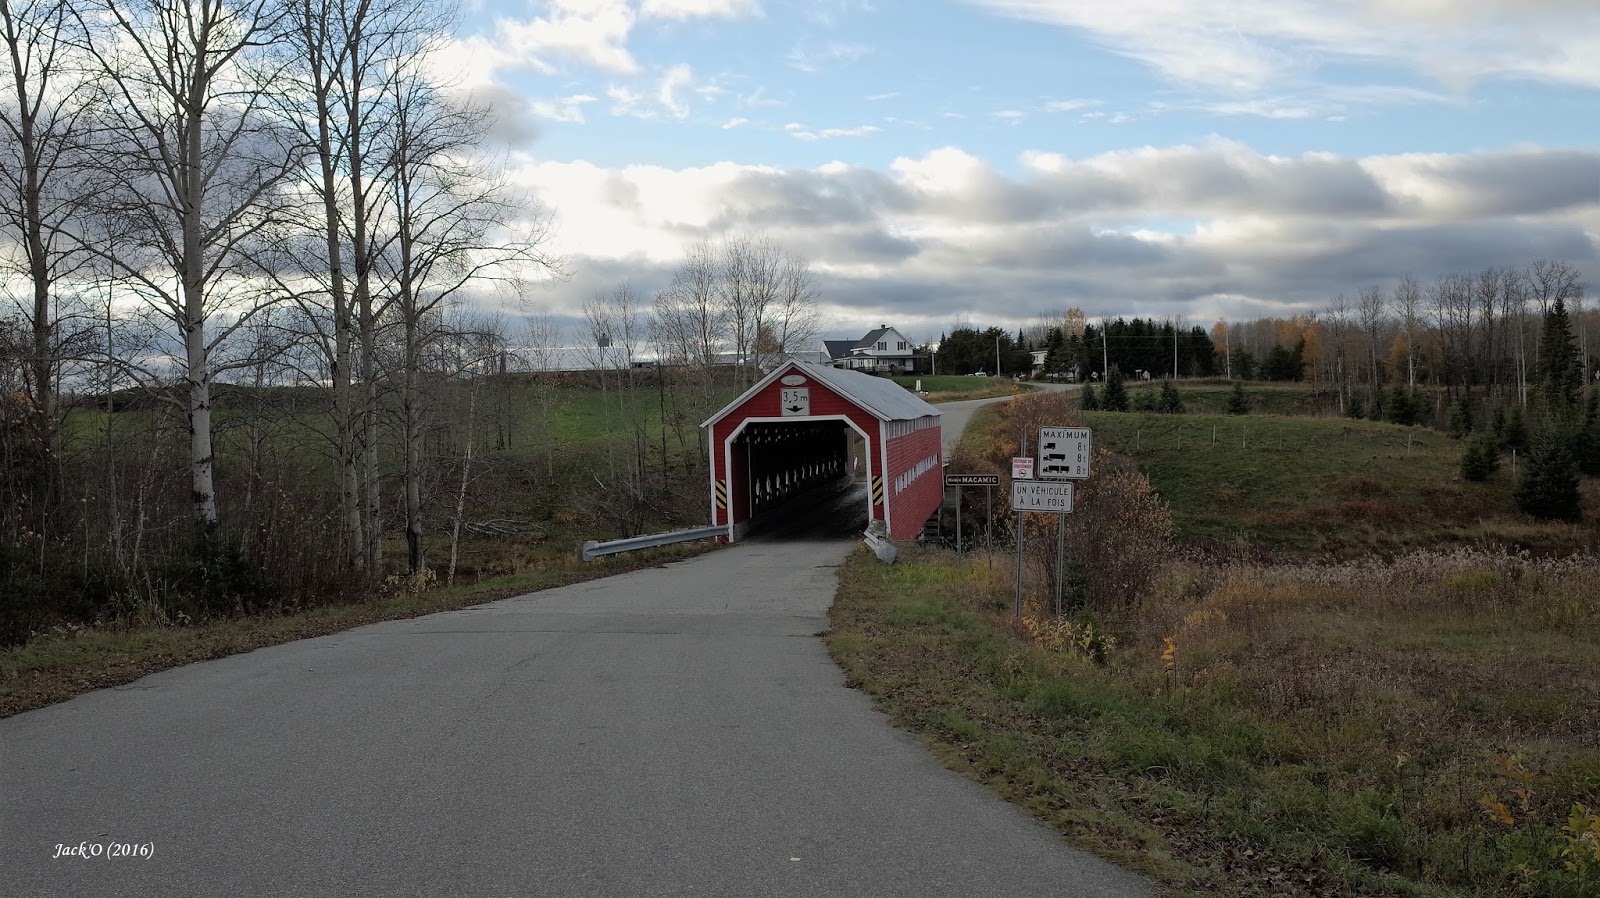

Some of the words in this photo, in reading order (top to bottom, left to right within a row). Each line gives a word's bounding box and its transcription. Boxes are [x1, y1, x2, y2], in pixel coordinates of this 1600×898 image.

[783, 391, 798, 403] 3,5
[1043, 431, 1087, 439] MAXIMUM
[1077, 442, 1082, 451] 8
[1077, 454, 1082, 463] 8
[1076, 466, 1081, 475] 8
[1016, 486, 1027, 494] UN
[1031, 485, 1068, 496] VÉHICULE
[1019, 496, 1025, 505] À
[1031, 497, 1041, 506] LA
[1047, 498, 1065, 507] FOIS
